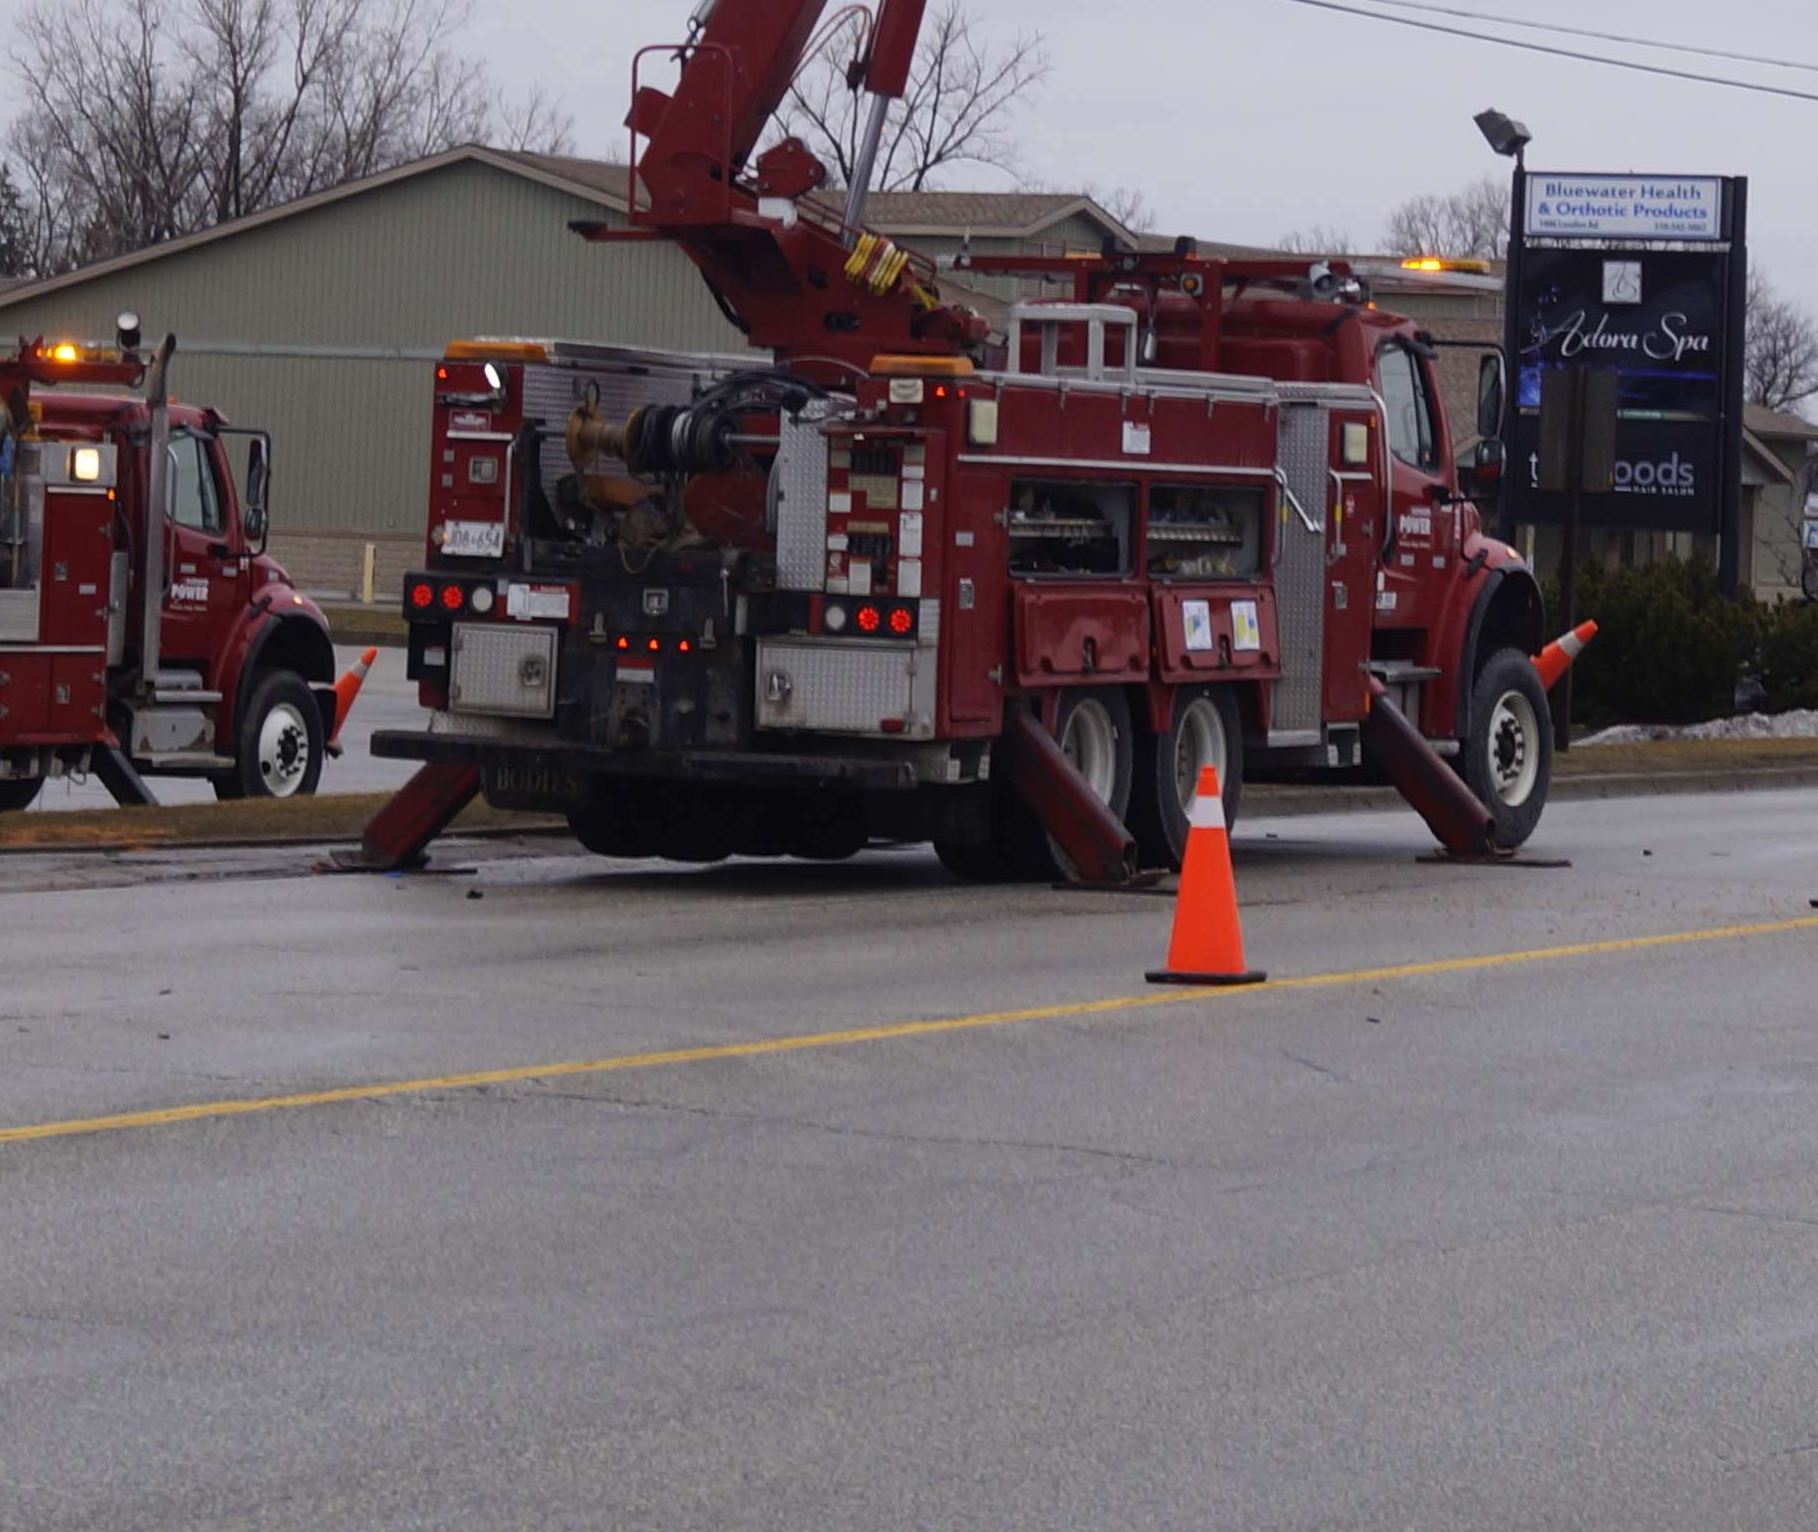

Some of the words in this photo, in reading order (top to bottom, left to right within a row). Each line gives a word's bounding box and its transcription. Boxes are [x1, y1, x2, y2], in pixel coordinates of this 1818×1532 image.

[1545, 182, 1635, 199] Bluewater
[1641, 184, 1702, 200] Health
[1538, 201, 1550, 216] &
[1556, 201, 1627, 217] Orthotic
[1633, 203, 1708, 219] Products
[1520, 309, 1639, 357] Adora
[1642, 310, 1710, 361] Spa
